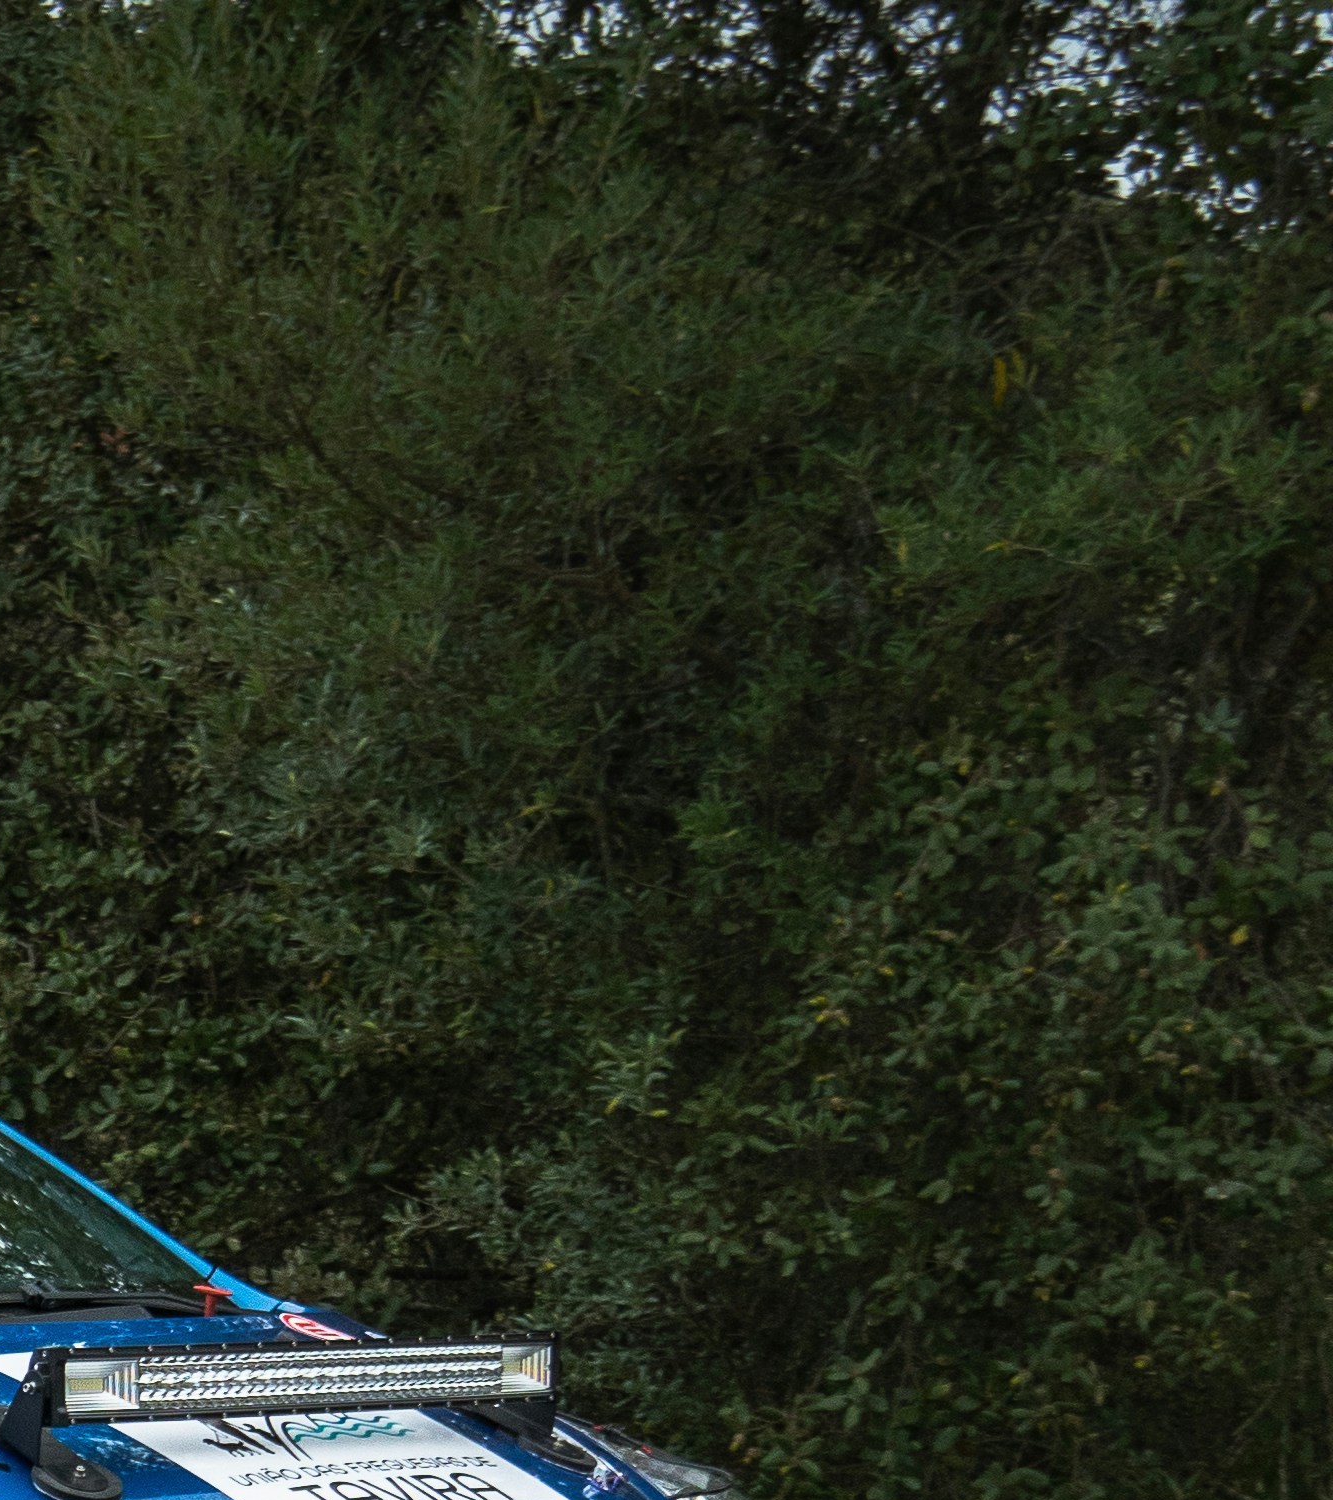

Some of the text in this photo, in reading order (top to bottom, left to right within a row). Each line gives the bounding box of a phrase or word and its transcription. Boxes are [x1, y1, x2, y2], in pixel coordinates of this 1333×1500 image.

[229, 1456, 498, 1487] UNIÃO DAS FREGUESIAS DE
